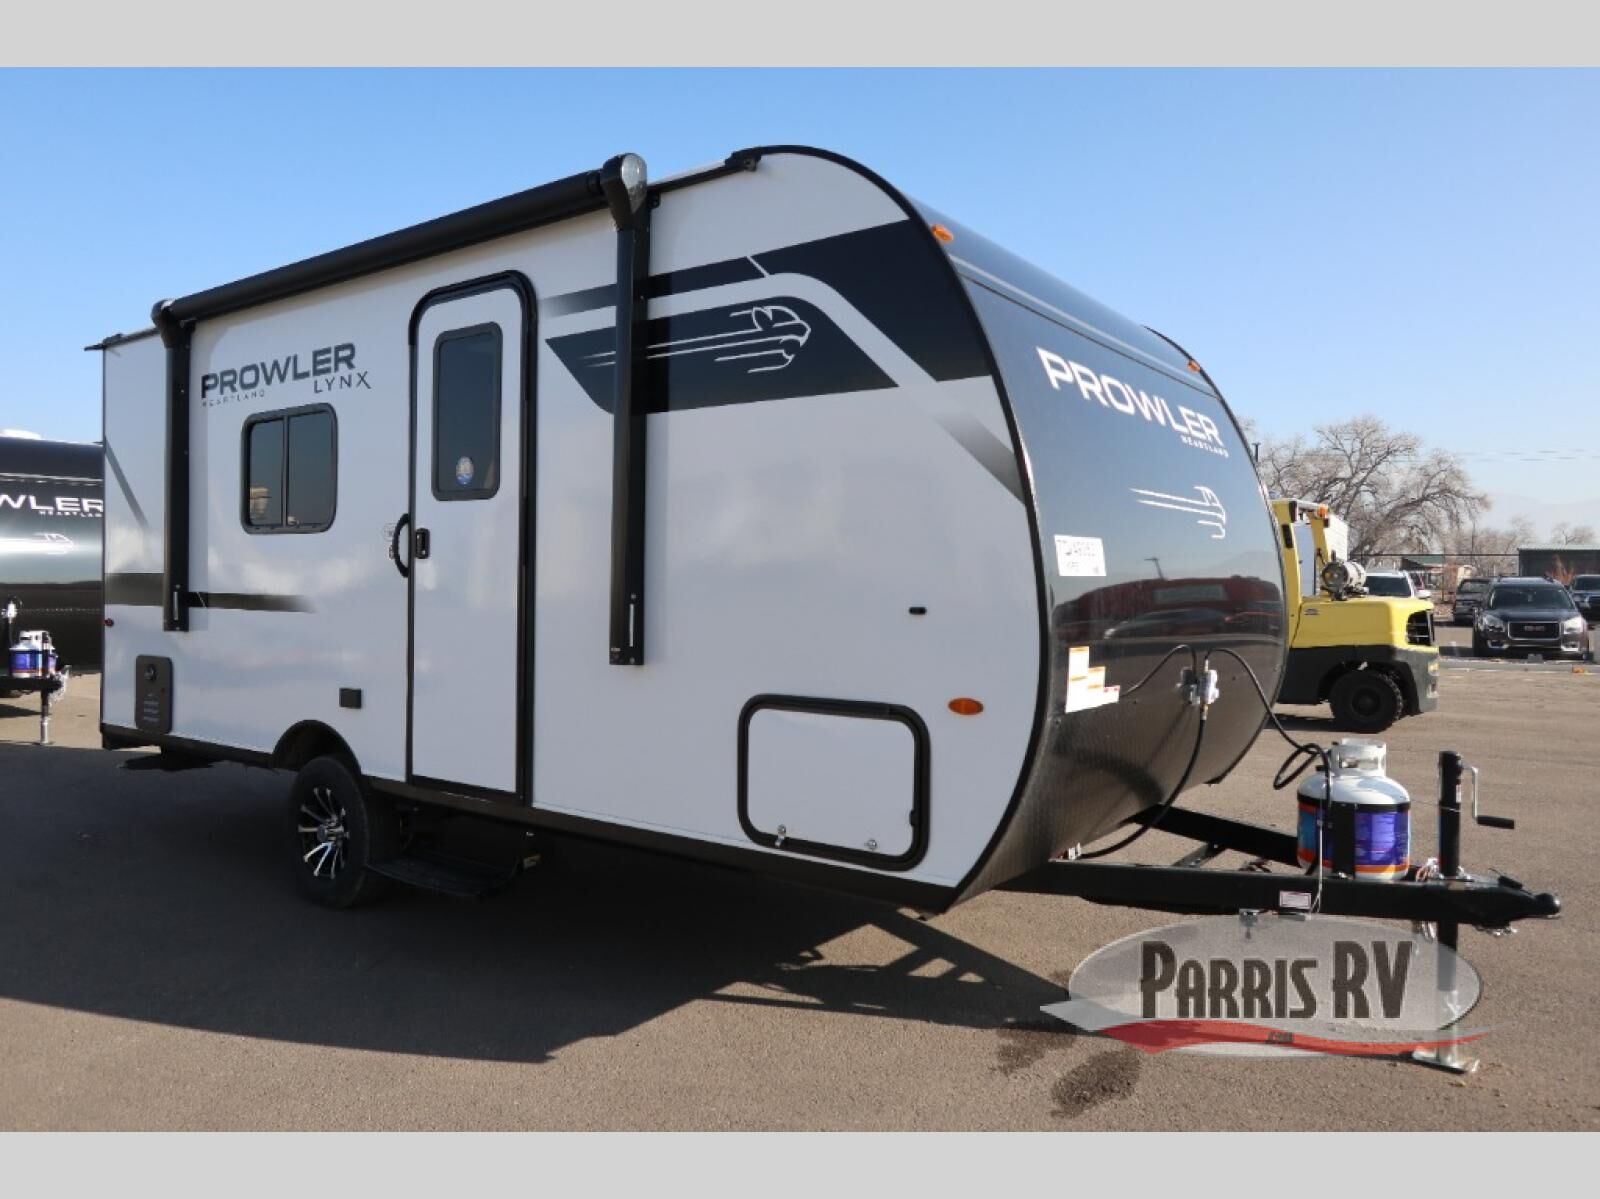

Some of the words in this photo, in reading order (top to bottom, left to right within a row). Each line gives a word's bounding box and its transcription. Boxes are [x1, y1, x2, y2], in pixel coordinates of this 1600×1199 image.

[201, 342, 356, 399] PROWLER
[313, 371, 372, 394] LYNX
[1035, 346, 1224, 447] PROWLER
